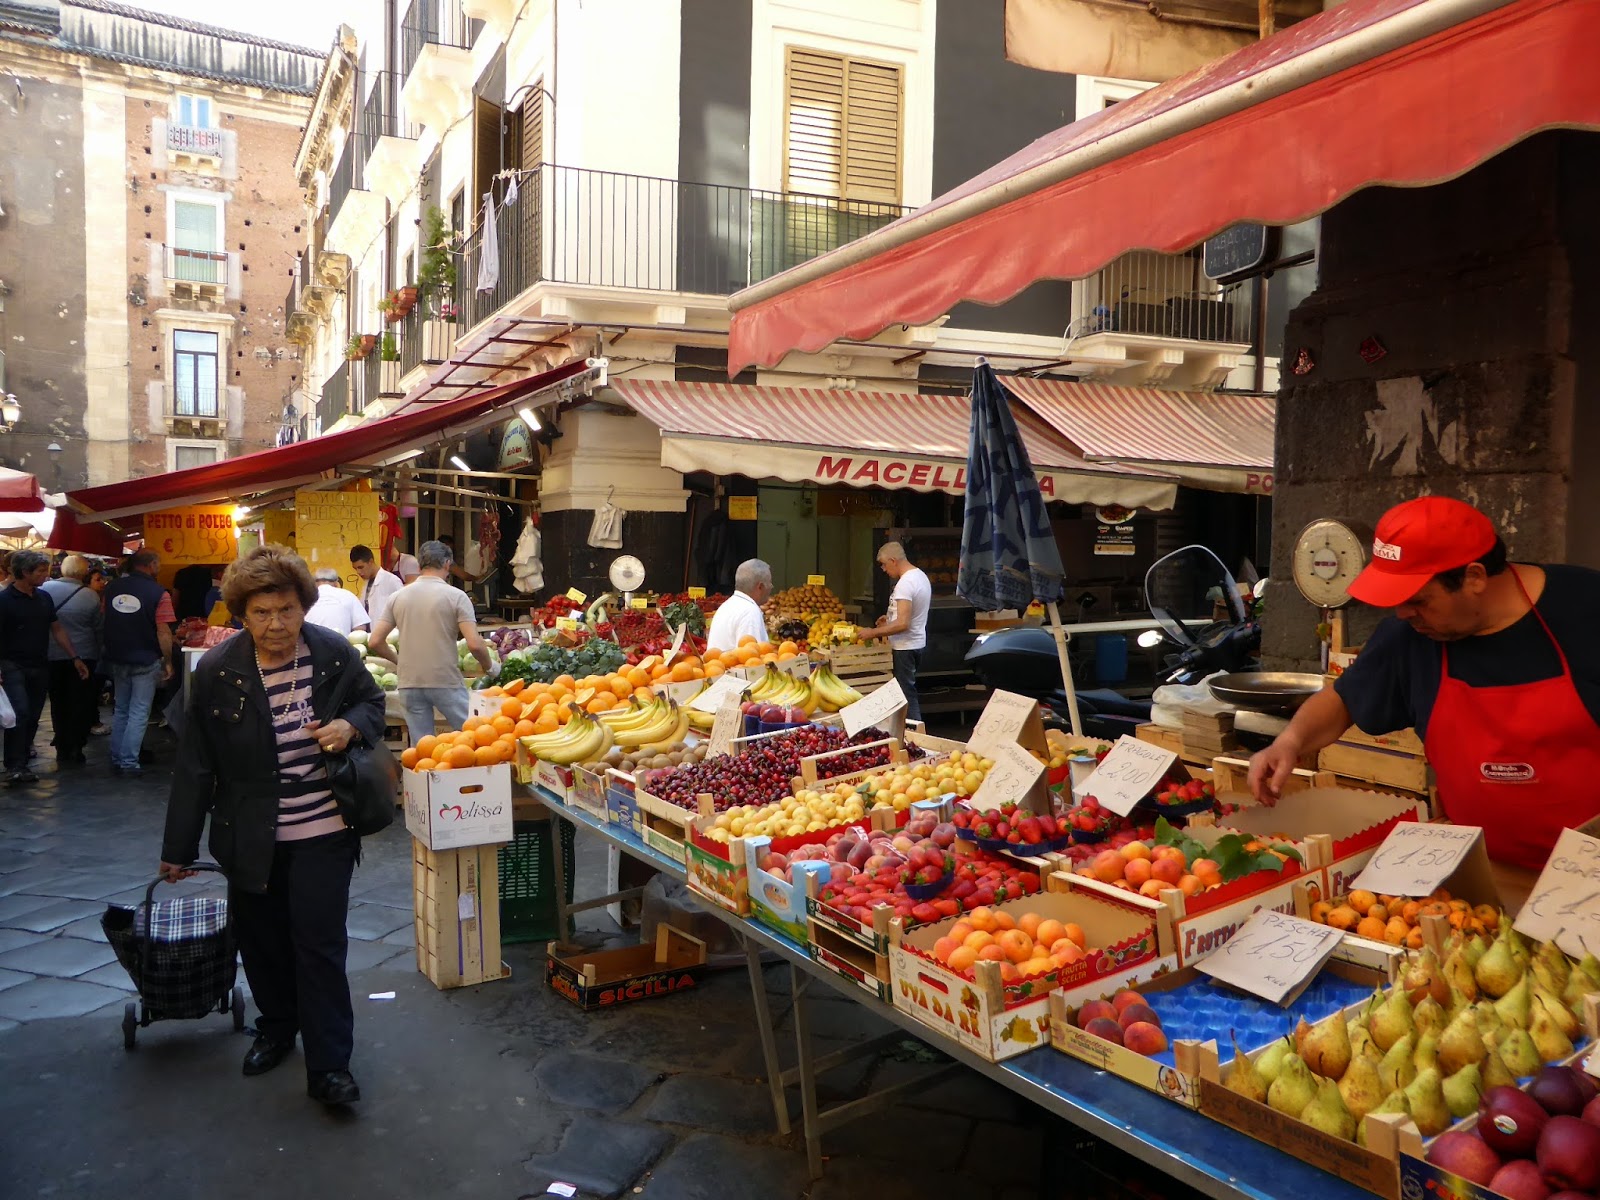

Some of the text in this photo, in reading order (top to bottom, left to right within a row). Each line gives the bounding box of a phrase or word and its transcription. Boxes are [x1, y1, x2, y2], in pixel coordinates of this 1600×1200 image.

[815, 455, 1055, 497] MACELLA
[148, 514, 183, 529] PETTO
[186, 514, 195, 529] di
[439, 801, 503, 822] Melissa
[1061, 960, 1088, 977] FRUTTA
[1061, 970, 1087, 986] SCELTA
[599, 974, 696, 1006] SICILIA
[899, 977, 929, 1010] UVA
[931, 994, 955, 1025] DA
